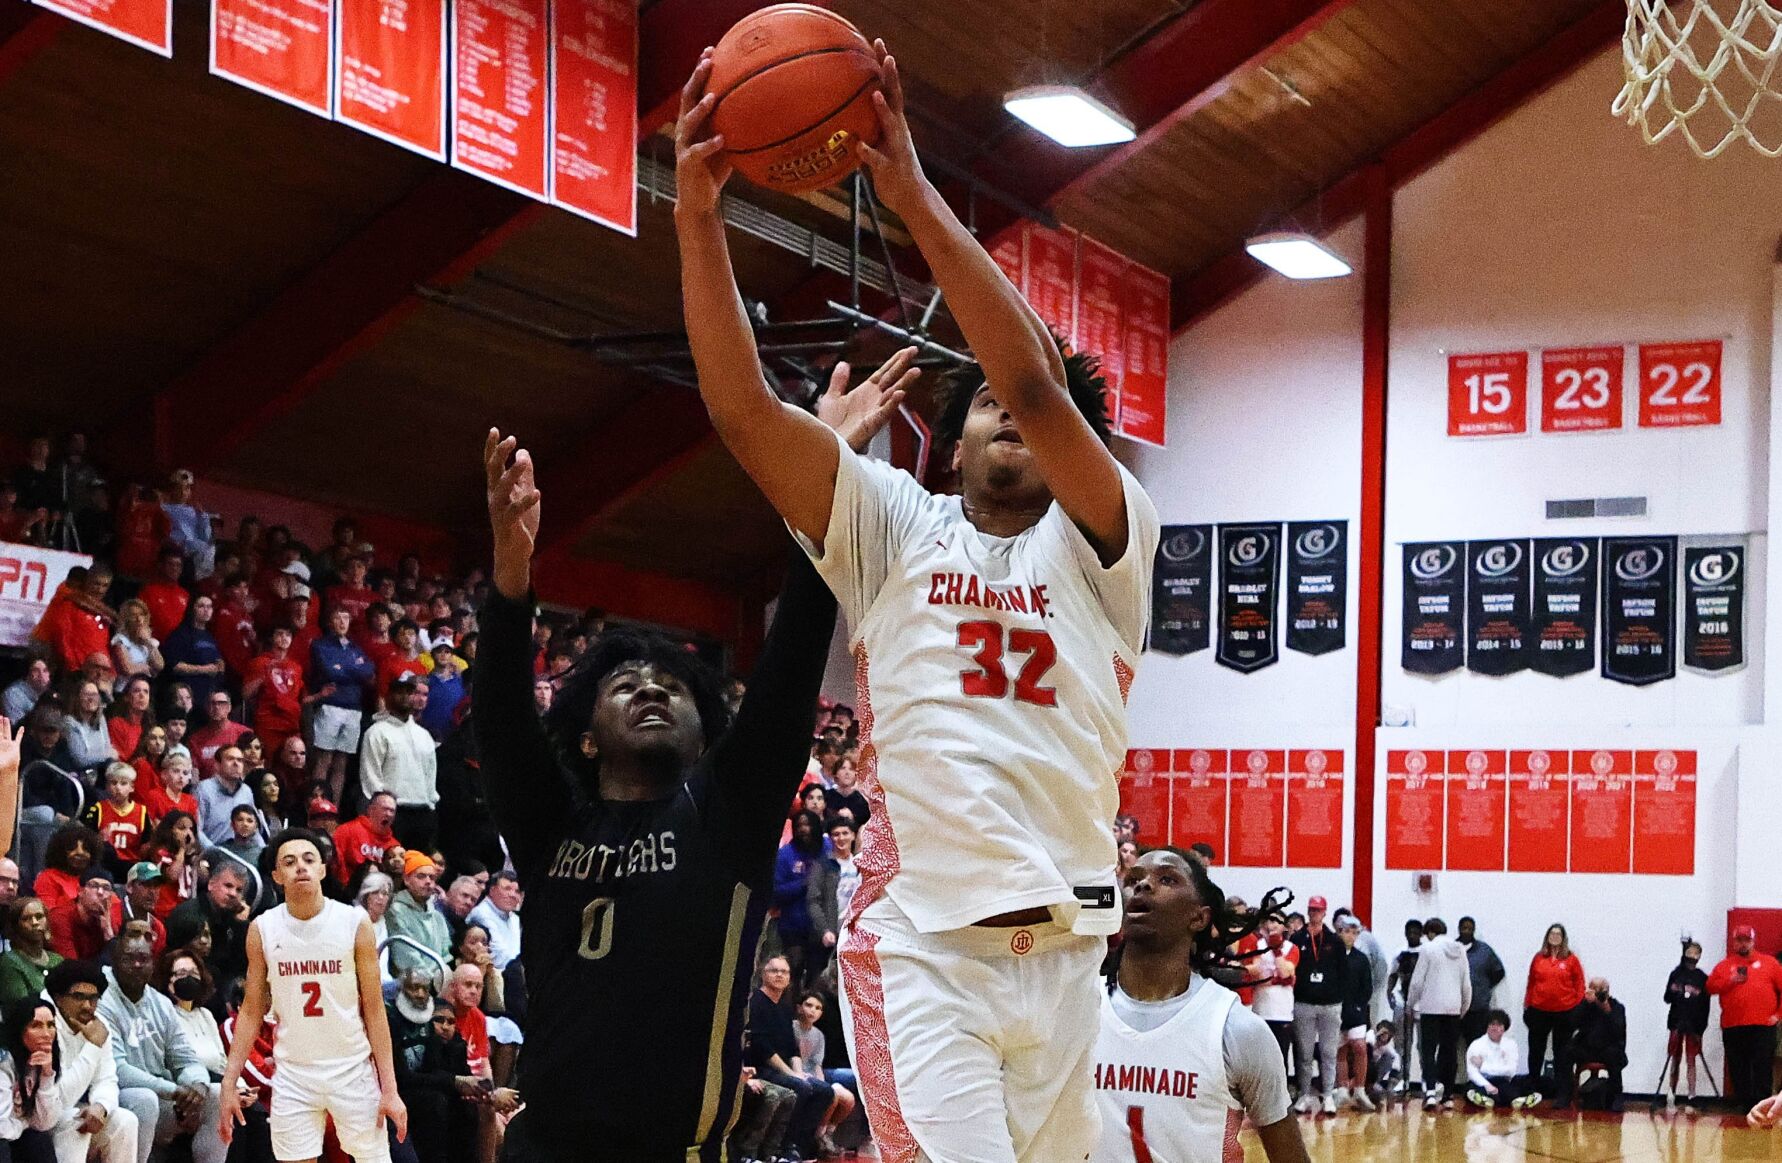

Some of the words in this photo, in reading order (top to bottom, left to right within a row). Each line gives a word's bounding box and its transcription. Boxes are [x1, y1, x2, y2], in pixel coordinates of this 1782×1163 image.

[1464, 372, 1512, 414] 15
[1554, 367, 1610, 410] 23
[1649, 361, 1712, 406] 22
[956, 620, 1058, 708] 32
[1102, 893, 1112, 902] XL
[578, 898, 614, 960] 0
[278, 960, 342, 977] CHAMINADE
[301, 981, 324, 1017] 2
[1094, 1062, 1198, 1100] HAMINADE
[1127, 1105, 1153, 1163] 1
